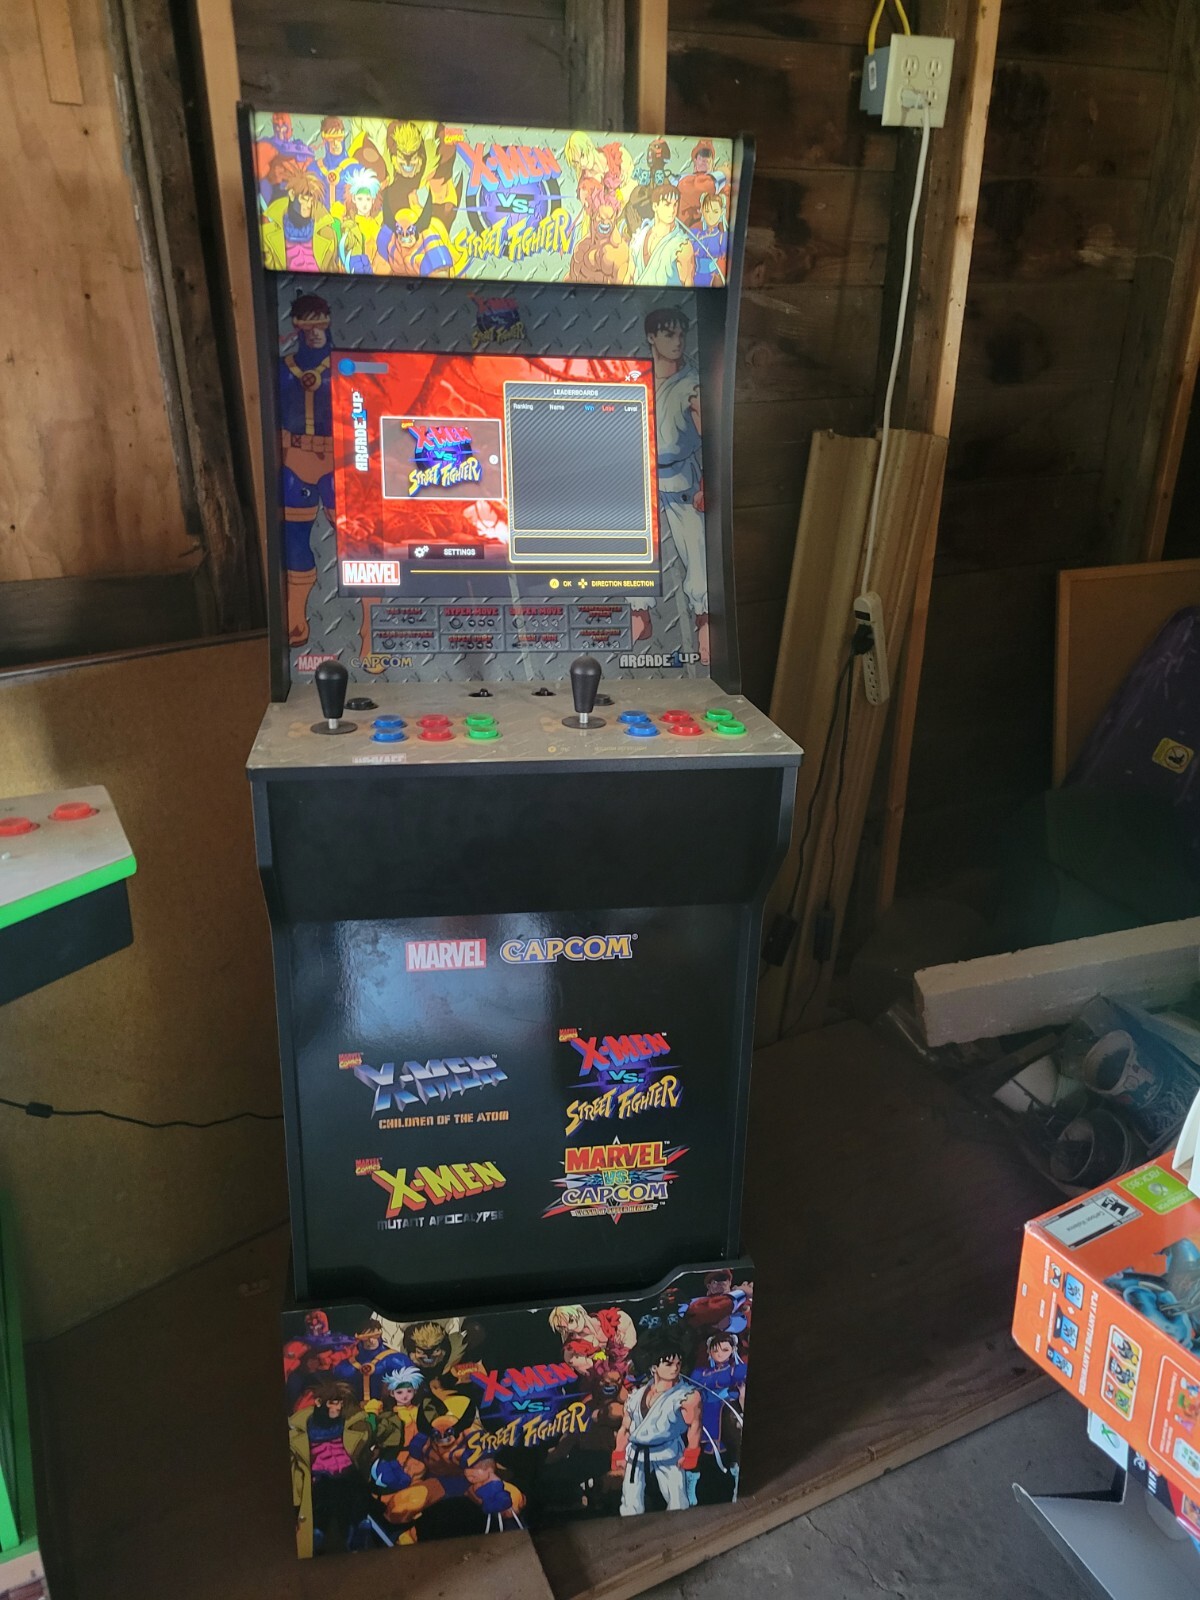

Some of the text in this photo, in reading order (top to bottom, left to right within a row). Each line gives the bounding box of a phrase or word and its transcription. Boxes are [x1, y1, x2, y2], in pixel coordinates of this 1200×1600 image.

[456, 142, 561, 196] X-MEN
[451, 208, 573, 277] STREET FIGHTER
[513, 402, 533, 411] Ranking
[549, 403, 565, 411] Name
[624, 404, 638, 412] Level
[553, 388, 599, 397] LEADERBOARDS
[408, 425, 473, 454] X-MEN
[408, 457, 482, 497] STREET FIGHTER
[443, 547, 476, 556] SETTINGS
[343, 563, 399, 584] MARVEL
[563, 580, 572, 588] OK
[591, 580, 623, 588] DIRECTION
[623, 580, 655, 588] SELECTION
[473, 607, 499, 616] MOVE
[539, 607, 563, 616] MOVE
[350, 656, 412, 669] CAPCOM
[408, 935, 633, 969] MARVEL CAPCOM
[570, 1033, 671, 1077] X-MEN
[354, 1056, 508, 1120] X-MEN
[379, 1110, 509, 1130] CHILDREN OF THE ATOM
[565, 1075, 683, 1136] STREET FIGHTER
[565, 1141, 667, 1173] MARVEL
[371, 1161, 506, 1219] X-MEN
[562, 1182, 668, 1207] CAPCOM
[470, 1362, 578, 1409] X-MEN
[467, 1402, 590, 1467] STREET FIGHTER
